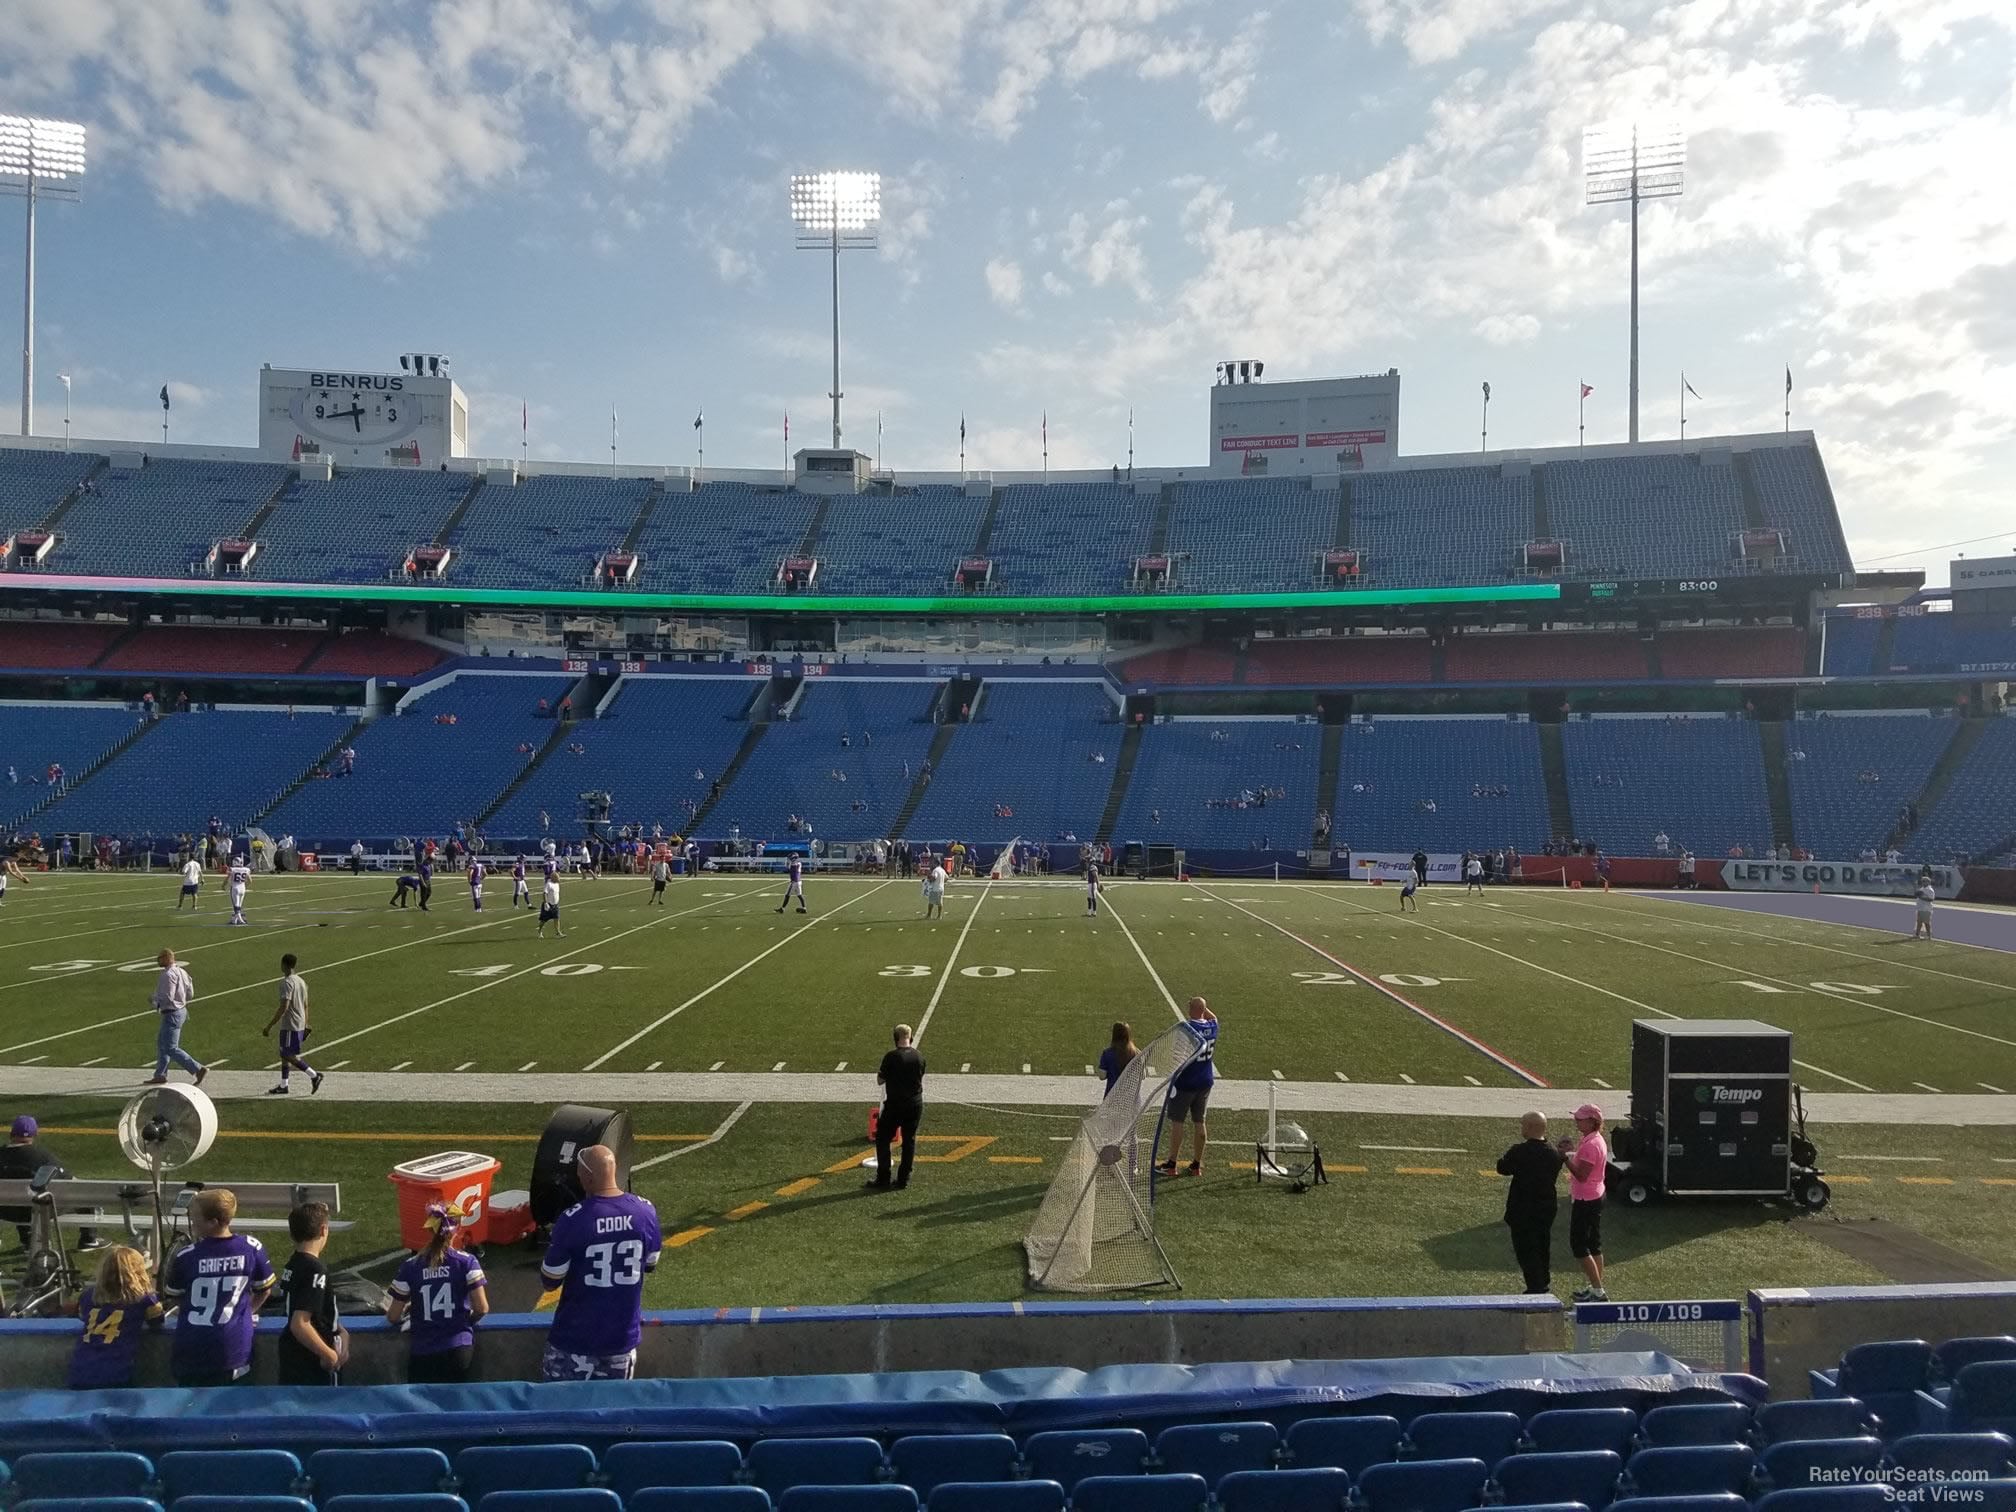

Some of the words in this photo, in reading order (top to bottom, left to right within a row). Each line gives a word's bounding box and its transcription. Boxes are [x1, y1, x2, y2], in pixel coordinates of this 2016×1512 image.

[311, 373, 403, 391] BENRUS
[315, 405, 325, 418] 9
[388, 408, 397, 422] 3
[1223, 440, 1236, 449] FAN
[1236, 440, 1266, 448] CONDUCT
[1266, 439, 1282, 447] TEXT
[1282, 438, 1297, 446] LINE
[1590, 582, 1618, 590] MINNESOTA
[1679, 580, 1718, 591] 83:00
[1897, 605, 1924, 617] 240
[568, 661, 588, 672] 132
[620, 662, 641, 672] 133
[753, 664, 773, 675] 133
[803, 665, 823, 675] 134
[1734, 863, 1796, 881] LET'S
[1802, 865, 1835, 882] GO
[1711, 1085, 1762, 1104] Tempo
[454, 1183, 482, 1227] G
[596, 1215, 633, 1234] COOK
[198, 1255, 245, 1273] GRIFFEN
[584, 1239, 644, 1288] 33
[422, 1265, 450, 1279] DIGGS
[312, 1273, 326, 1289] 14
[187, 1275, 249, 1327] 97
[419, 1283, 455, 1322] 14
[82, 1308, 124, 1344] 14
